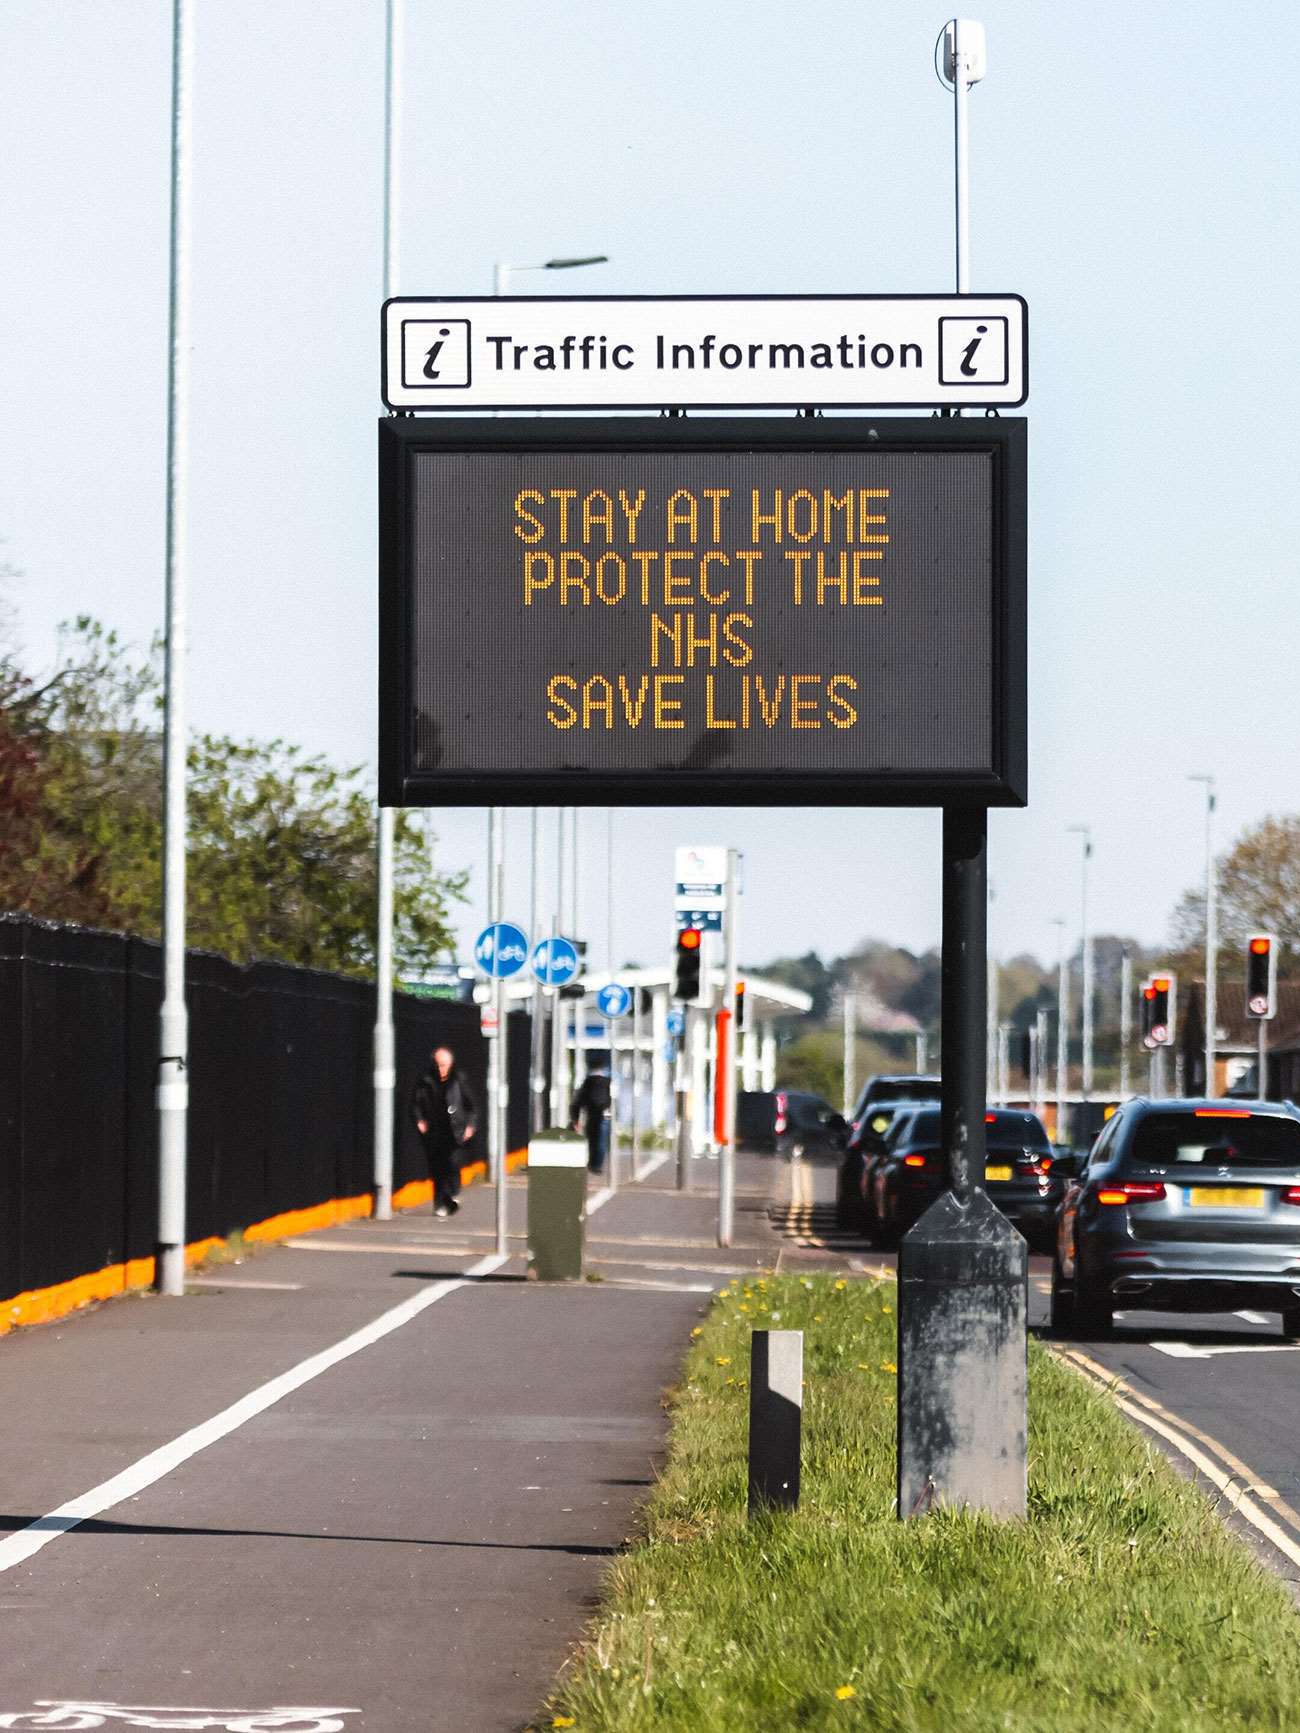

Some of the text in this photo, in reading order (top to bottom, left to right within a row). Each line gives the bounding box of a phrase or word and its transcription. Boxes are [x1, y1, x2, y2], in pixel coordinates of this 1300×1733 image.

[486, 335, 634, 370] Traffic
[657, 334, 922, 369] Information
[514, 490, 890, 543] STAY AT HOME
[524, 551, 883, 605] PROTECT THE
[651, 613, 753, 667] NHS
[547, 675, 858, 729] SAVE LIVES
